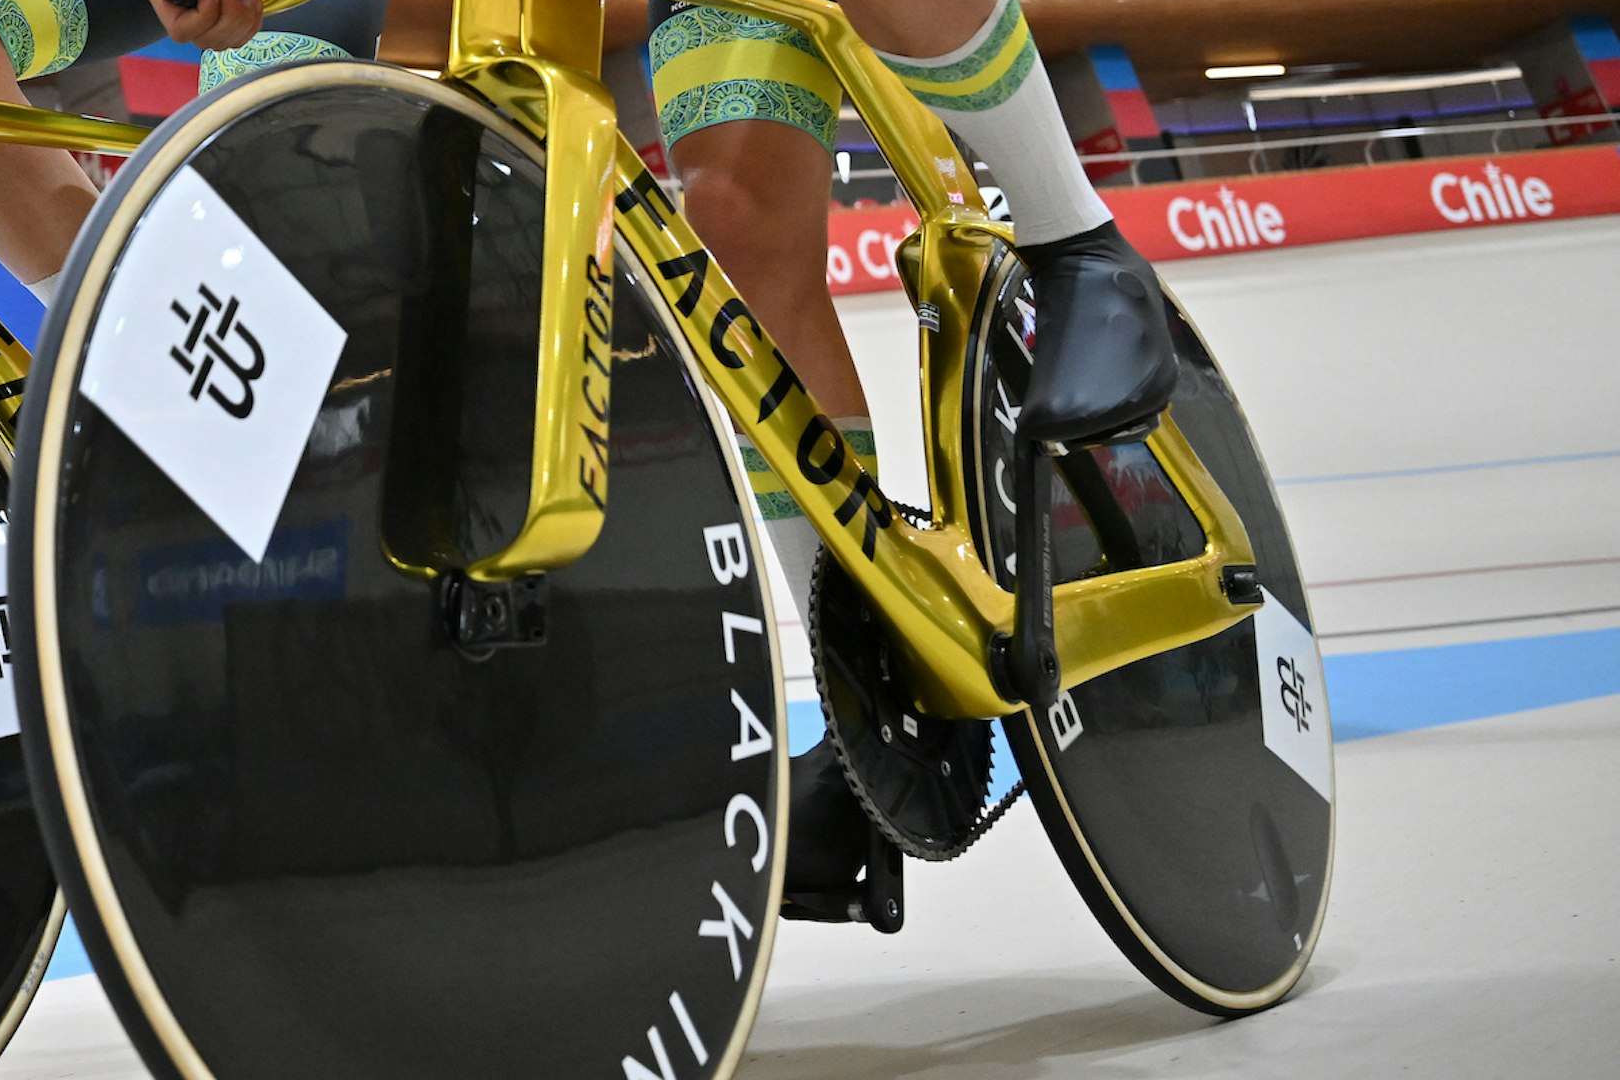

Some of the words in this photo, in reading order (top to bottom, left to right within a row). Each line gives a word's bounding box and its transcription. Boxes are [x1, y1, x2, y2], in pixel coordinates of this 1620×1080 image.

[1167, 186, 1286, 252] Chile
[1430, 163, 1555, 223] Chile
[579, 254, 613, 515] FACTOR
[615, 167, 895, 563] FACTOR
[698, 522, 773, 982] BLACK
[621, 990, 709, 1080] IN
